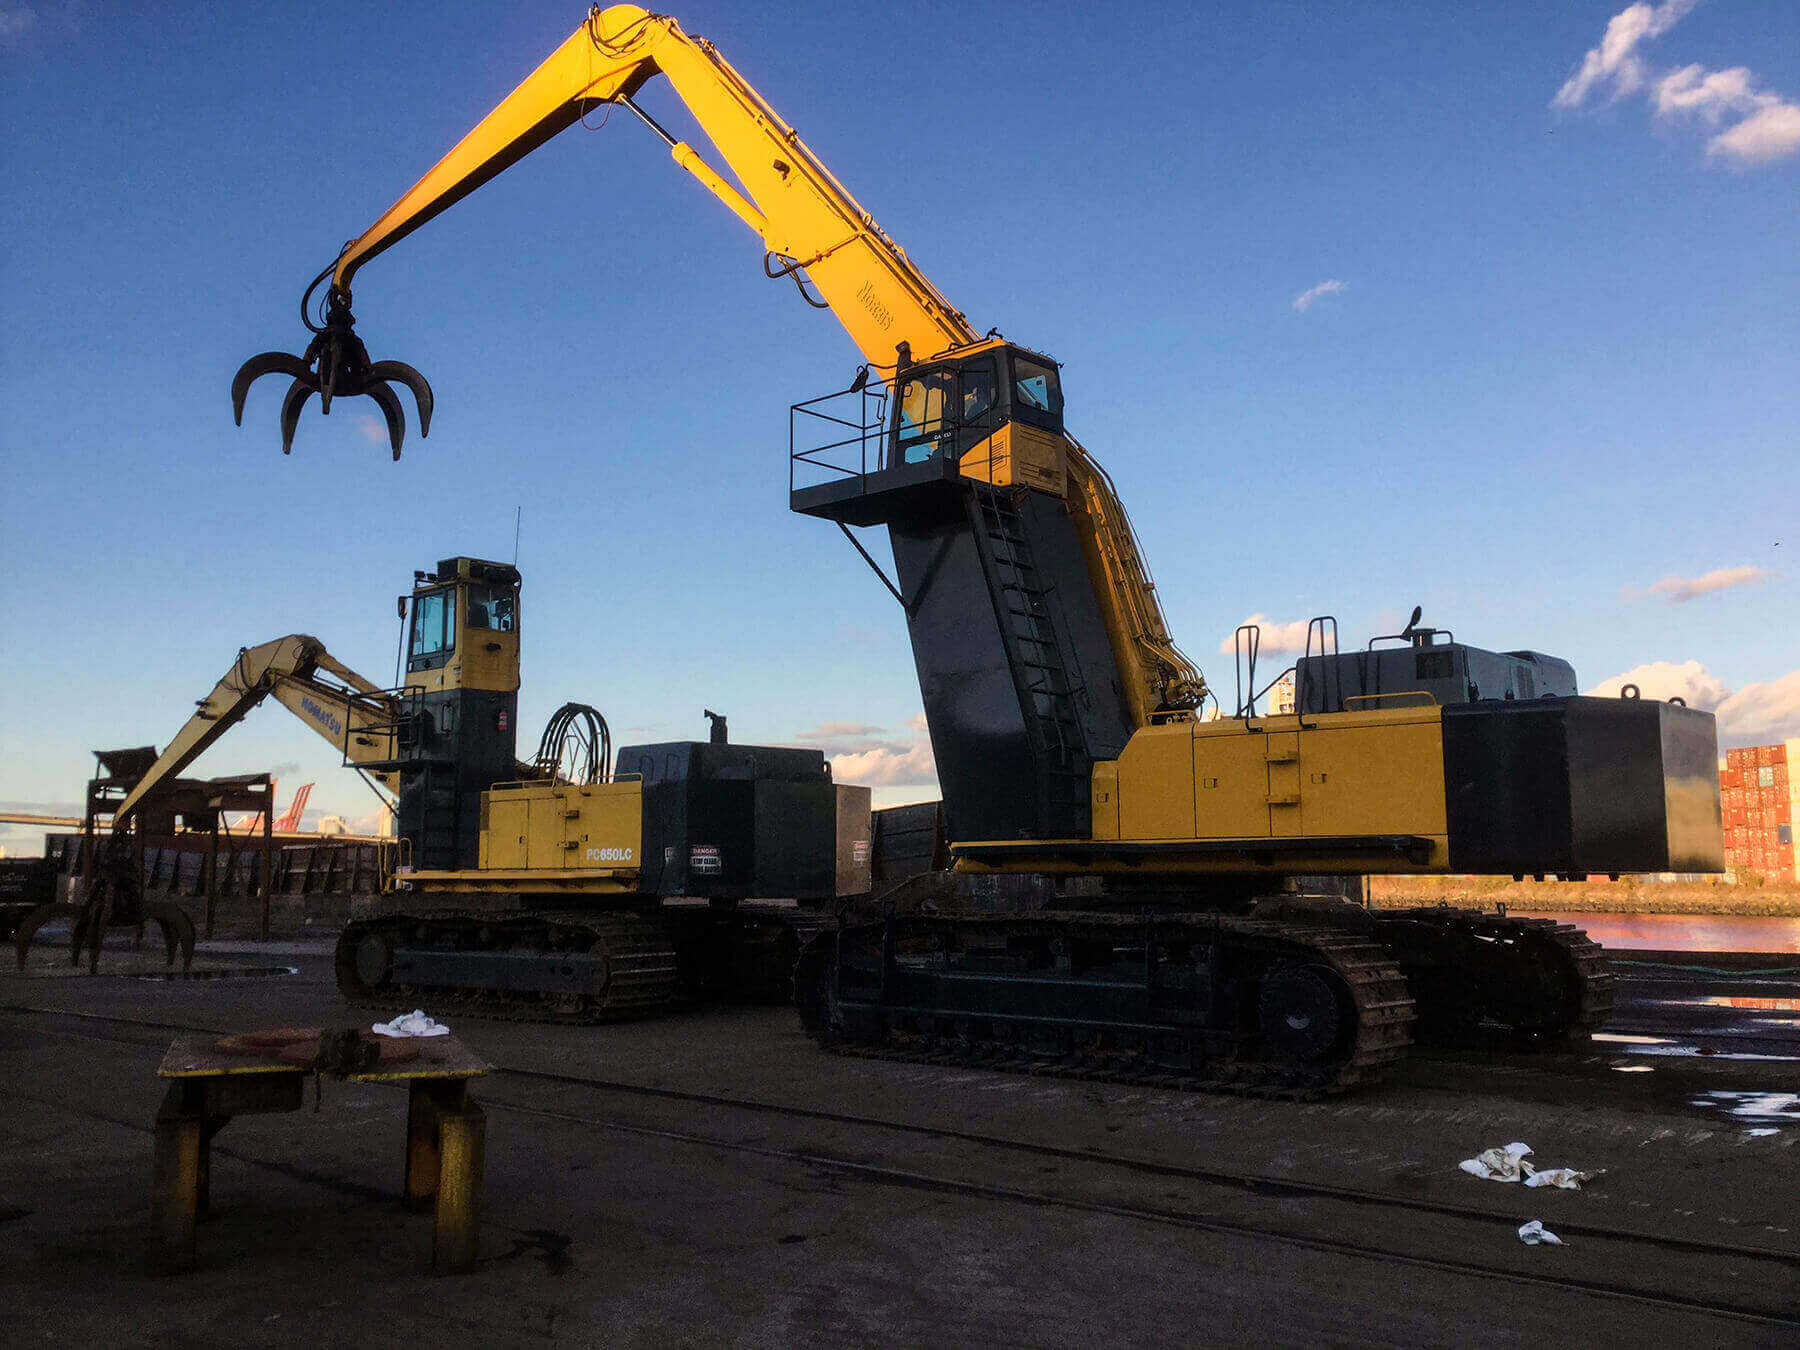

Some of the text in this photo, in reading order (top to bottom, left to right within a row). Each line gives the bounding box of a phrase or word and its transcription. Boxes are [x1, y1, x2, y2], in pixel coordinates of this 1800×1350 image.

[301, 697, 341, 734] KOMATSU
[586, 847, 632, 860] PC650LC
[692, 847, 719, 856] DANGER
